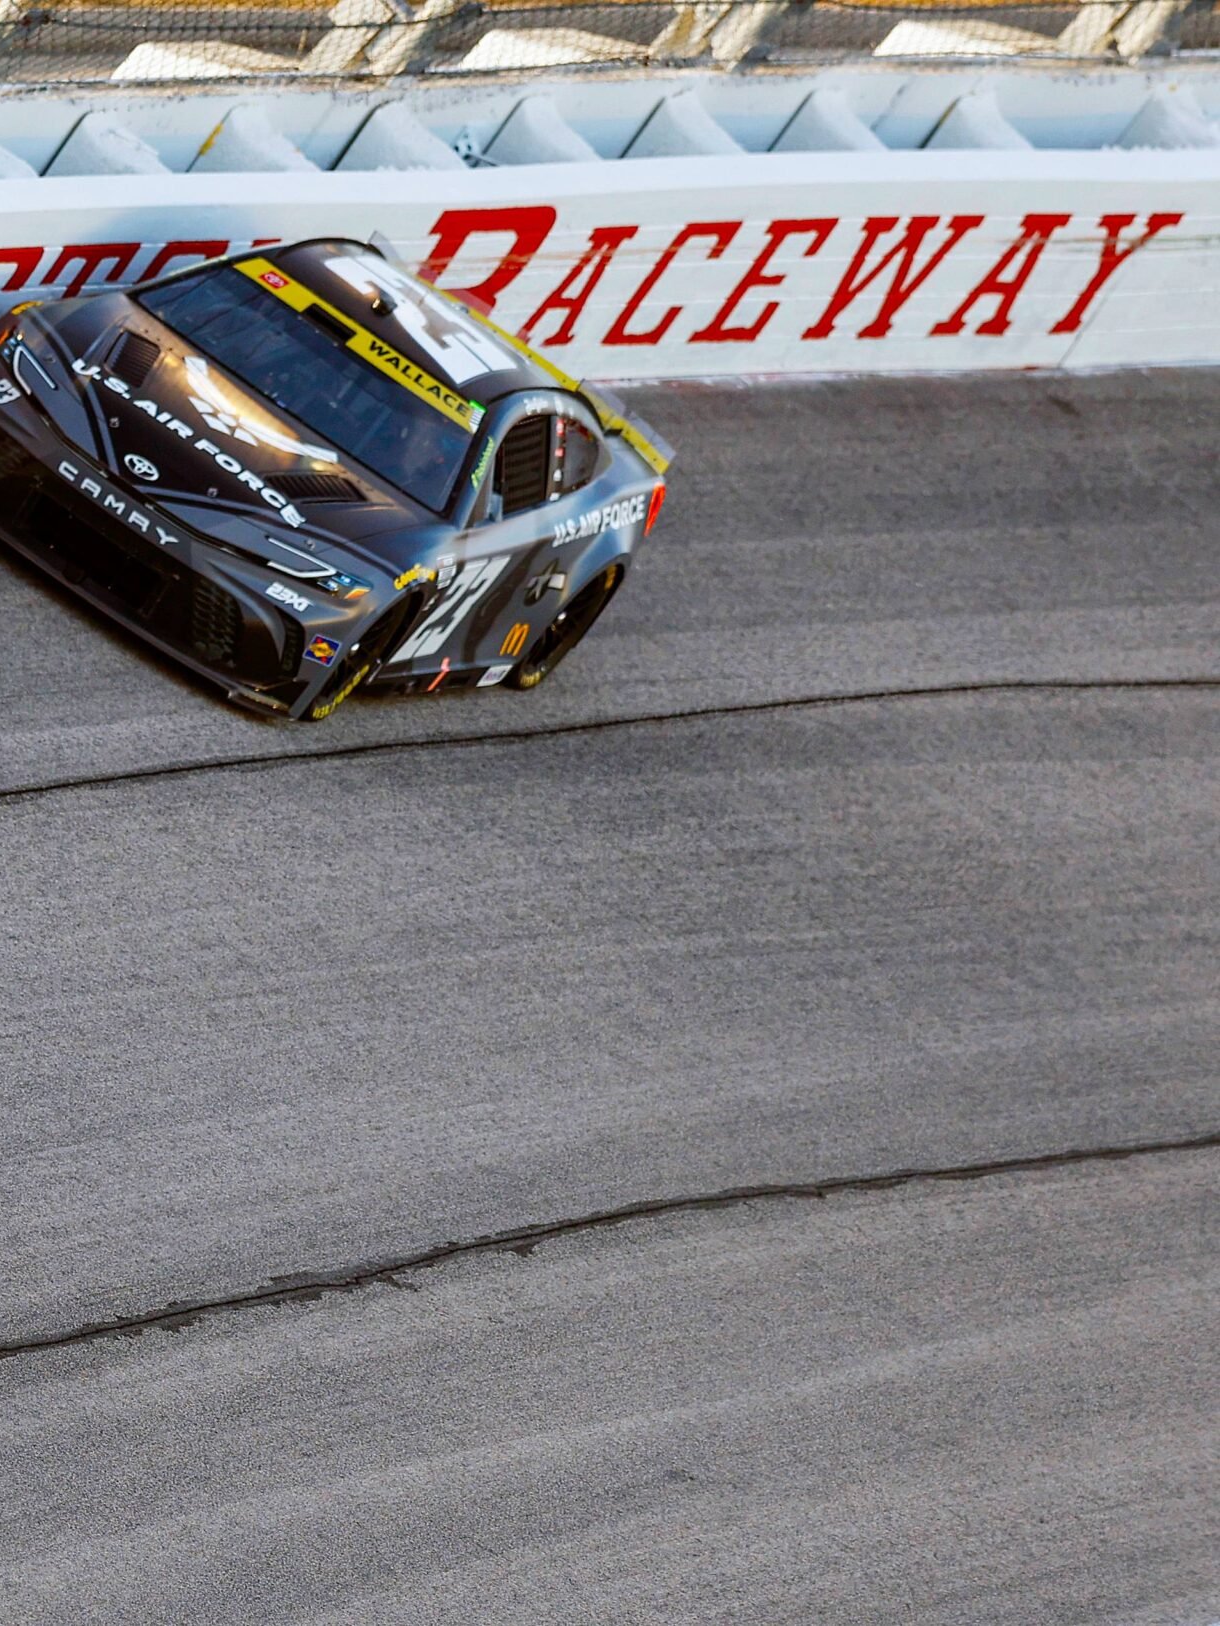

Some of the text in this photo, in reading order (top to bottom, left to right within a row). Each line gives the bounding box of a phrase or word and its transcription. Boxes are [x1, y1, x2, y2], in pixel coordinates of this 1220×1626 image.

[418, 205, 1185, 347] RACEWAY
[368, 340, 469, 418] WALLACE
[72, 358, 307, 529] U.S. AIR FORCE
[58, 460, 180, 546] CAMRY
[600, 493, 646, 534] FORCE
